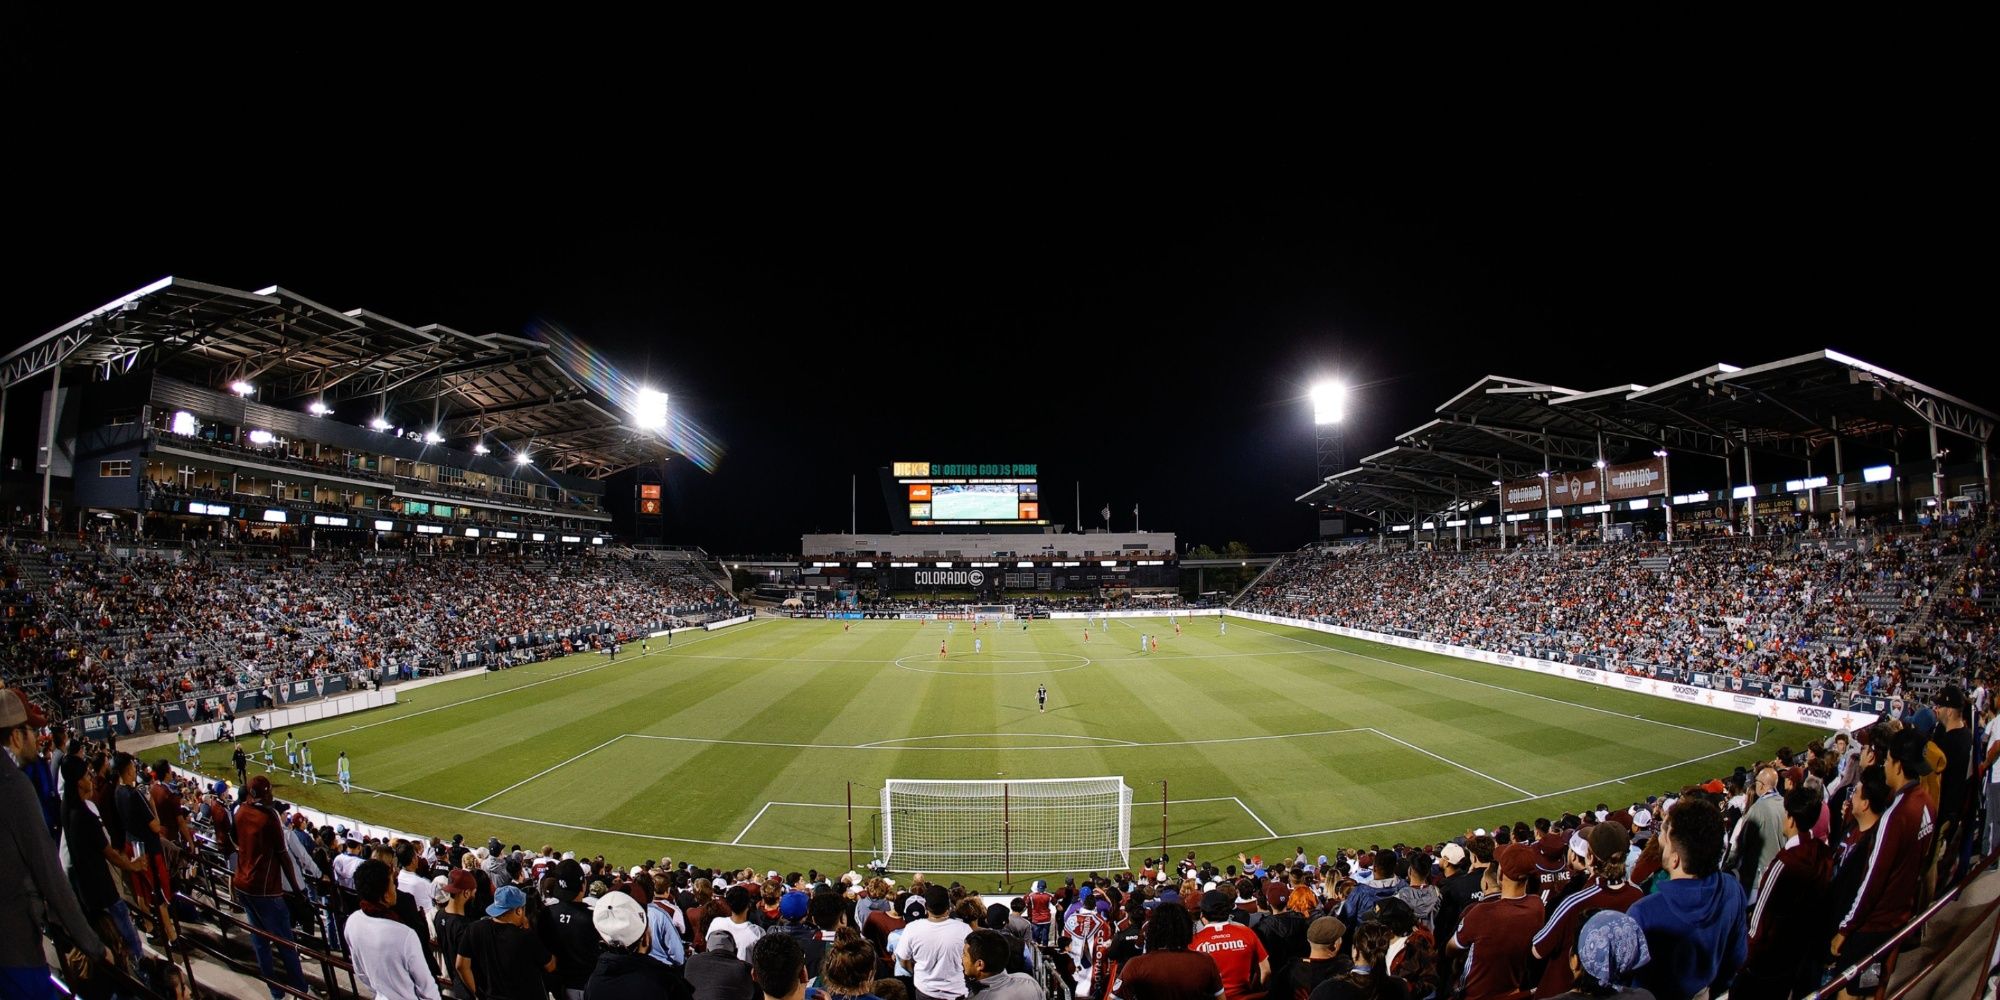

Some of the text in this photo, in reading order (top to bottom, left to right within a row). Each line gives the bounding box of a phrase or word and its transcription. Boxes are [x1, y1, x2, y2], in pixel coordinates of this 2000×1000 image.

[1012, 464, 1038, 476] PARK
[1508, 468, 1651, 504] COLORADO RAPIDS
[914, 571, 968, 585] COLORADO
[1672, 685, 1699, 696] ROCKSTAR
[1797, 706, 1832, 719] ROCKSTAR
[559, 914, 571, 924] 27
